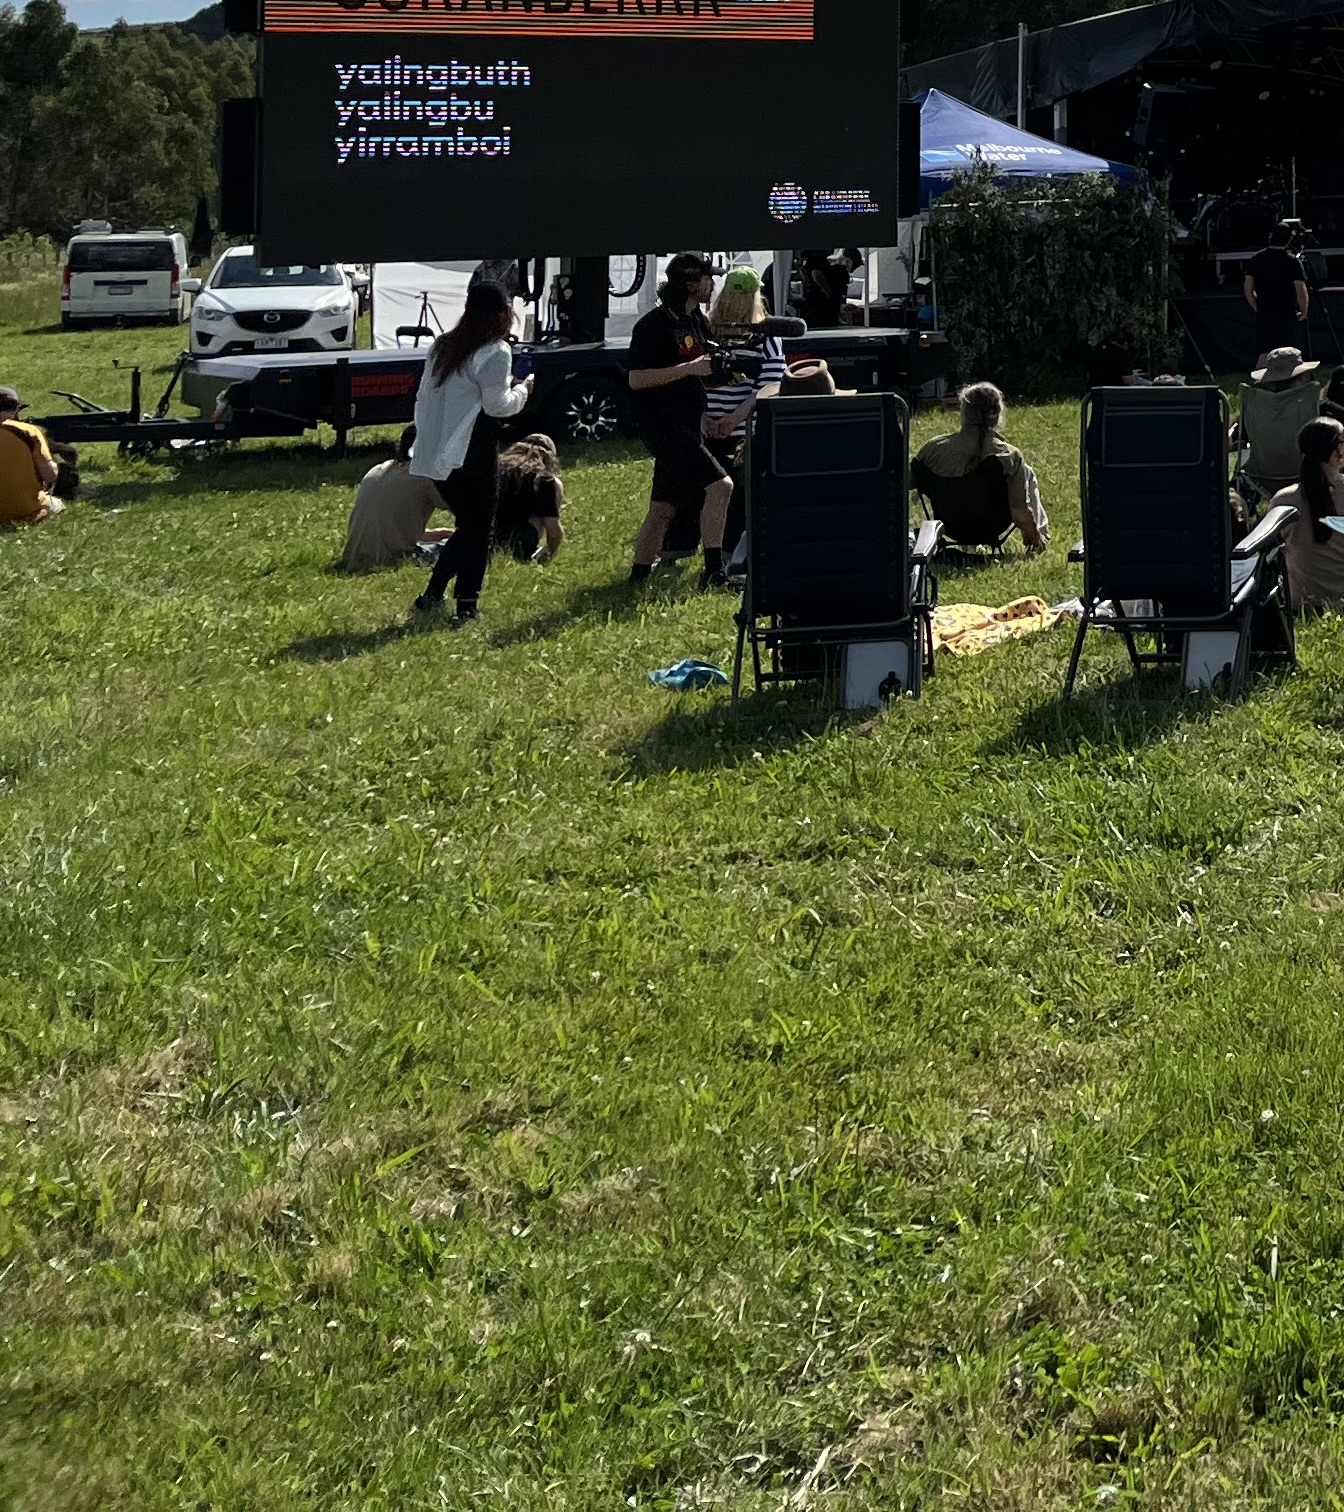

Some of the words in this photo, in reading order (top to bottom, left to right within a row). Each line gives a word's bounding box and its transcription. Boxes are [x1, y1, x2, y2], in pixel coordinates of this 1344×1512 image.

[335, 55, 531, 92] yalingbuth
[334, 90, 494, 128] yalingbu
[334, 126, 512, 165] yirramboi
